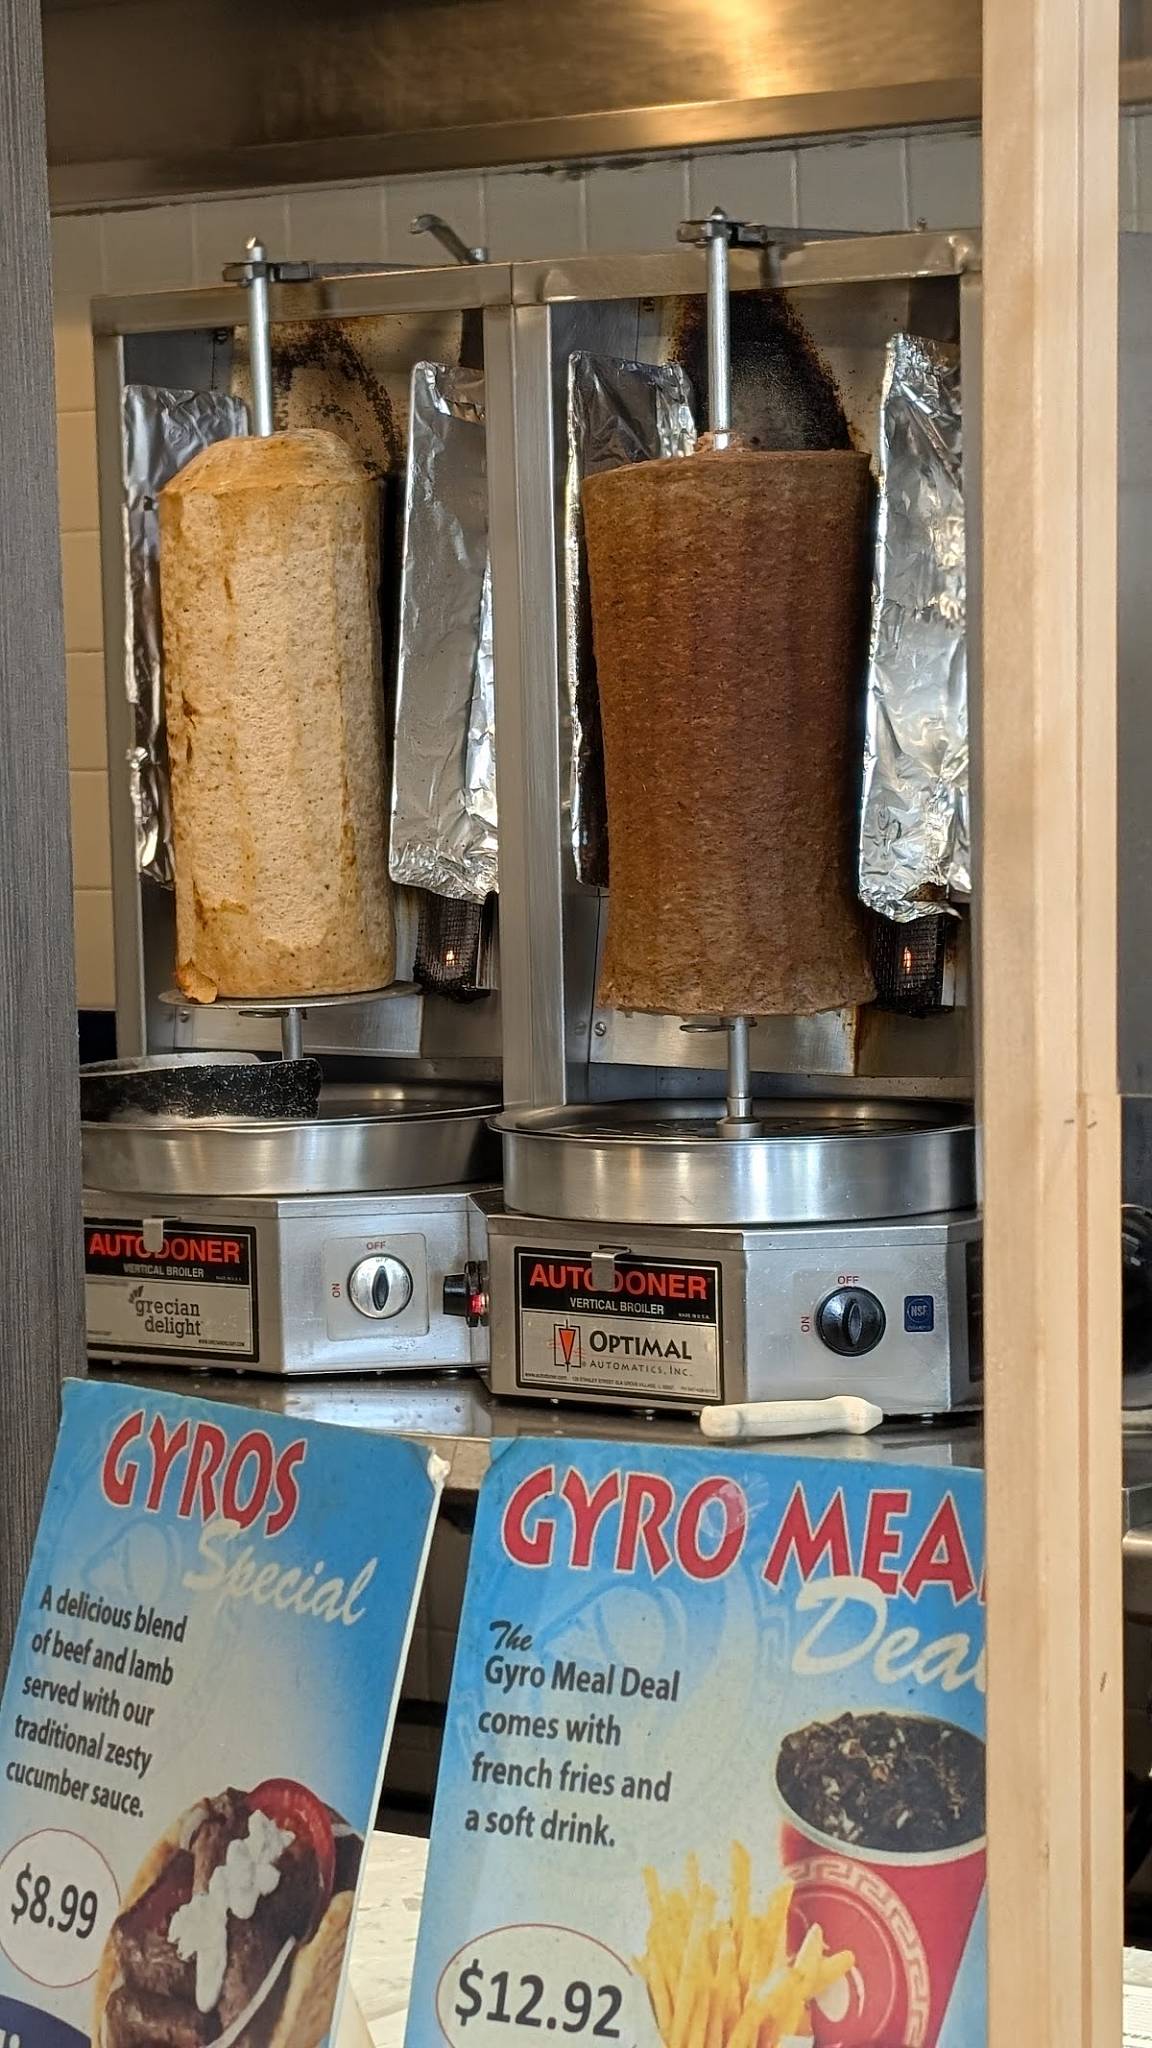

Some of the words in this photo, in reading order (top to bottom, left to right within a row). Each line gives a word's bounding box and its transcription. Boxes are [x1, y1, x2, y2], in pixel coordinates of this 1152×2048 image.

[366, 1241, 386, 1250] OFF
[122, 1263, 165, 1276] VERTICAL
[166, 1266, 205, 1278] BROILER
[331, 1283, 341, 1298] ON
[837, 1275, 860, 1285] OFF
[135, 1298, 201, 1317] grecian
[569, 1297, 618, 1312] VERTICAL
[619, 1301, 665, 1315] BROILER
[800, 1316, 811, 1333] ON
[144, 1316, 202, 1339] delight
[589, 1330, 693, 1361] OPTIMAL
[589, 1360, 668, 1376] AUTOMATICS,
[669, 1364, 694, 1378] INC.
[103, 1409, 308, 1536] GYROS
[501, 1465, 748, 1582] GYRO
[761, 1480, 986, 1606] MEA
[183, 1518, 377, 1627] Special
[39, 1585, 53, 1612] A
[56, 1587, 132, 1630] delicious
[134, 1605, 188, 1643] blend
[32, 1628, 53, 1654] of
[52, 1630, 93, 1664] beef
[92, 1644, 127, 1675] and
[129, 1651, 174, 1686] lamb
[489, 1621, 533, 1653] The
[485, 1655, 547, 1697] Gyro
[551, 1660, 614, 1695] Meal
[620, 1668, 680, 1702] Deal
[22, 1675, 79, 1708] served
[82, 1688, 121, 1719] with
[123, 1704, 155, 1727] our
[14, 1714, 103, 1760] traditional
[104, 1743, 153, 1779] zesty
[478, 1711, 559, 1740] comes
[566, 1713, 621, 1746] with
[6, 1761, 90, 1801] cucumber
[90, 1784, 144, 1817] sauce.
[471, 1752, 553, 1791] french
[559, 1761, 616, 1796] fries
[620, 1772, 671, 1802] and
[464, 1810, 480, 1832] a
[484, 1805, 536, 1838] soft
[540, 1811, 616, 1847] drink.
[11, 1863, 97, 1940] $8.99
[455, 1958, 623, 2039] $12.92
